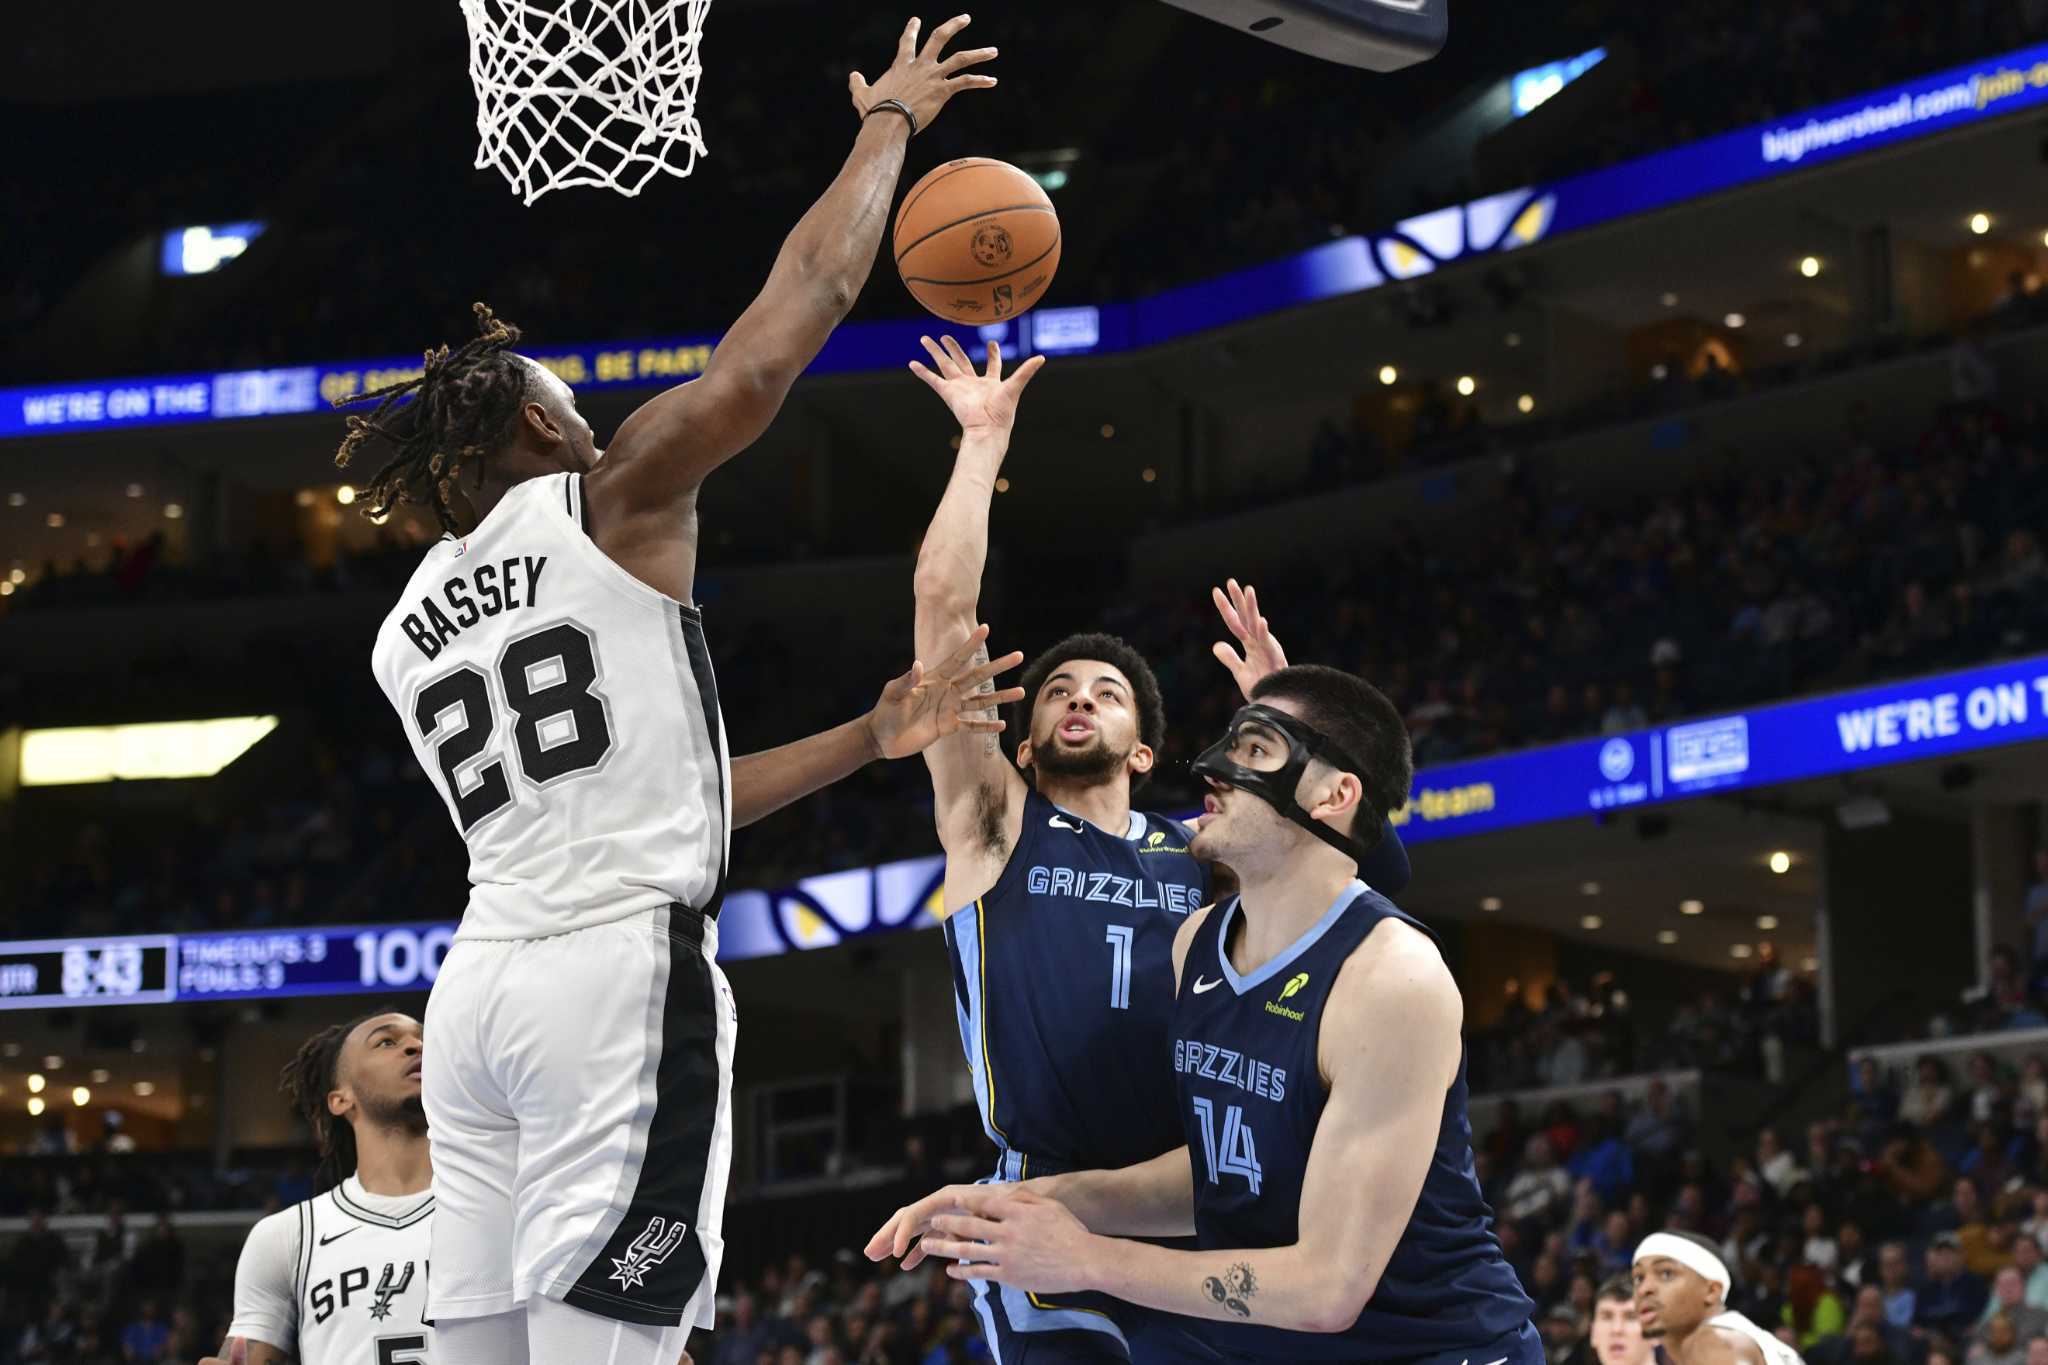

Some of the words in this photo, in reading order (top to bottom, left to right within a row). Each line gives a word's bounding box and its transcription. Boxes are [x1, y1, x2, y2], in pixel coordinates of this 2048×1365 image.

[595, 351, 634, 381] BE
[400, 556, 548, 662] BASSEY
[411, 616, 619, 842] 28
[1836, 692, 1961, 753] WE'RE
[1964, 680, 2028, 731] ON
[1027, 865, 1202, 916] GRIZZLIES
[1105, 923, 1134, 1010] 1
[1265, 1000, 1304, 1021] Robinhood
[1192, 1095, 1262, 1196] 14
